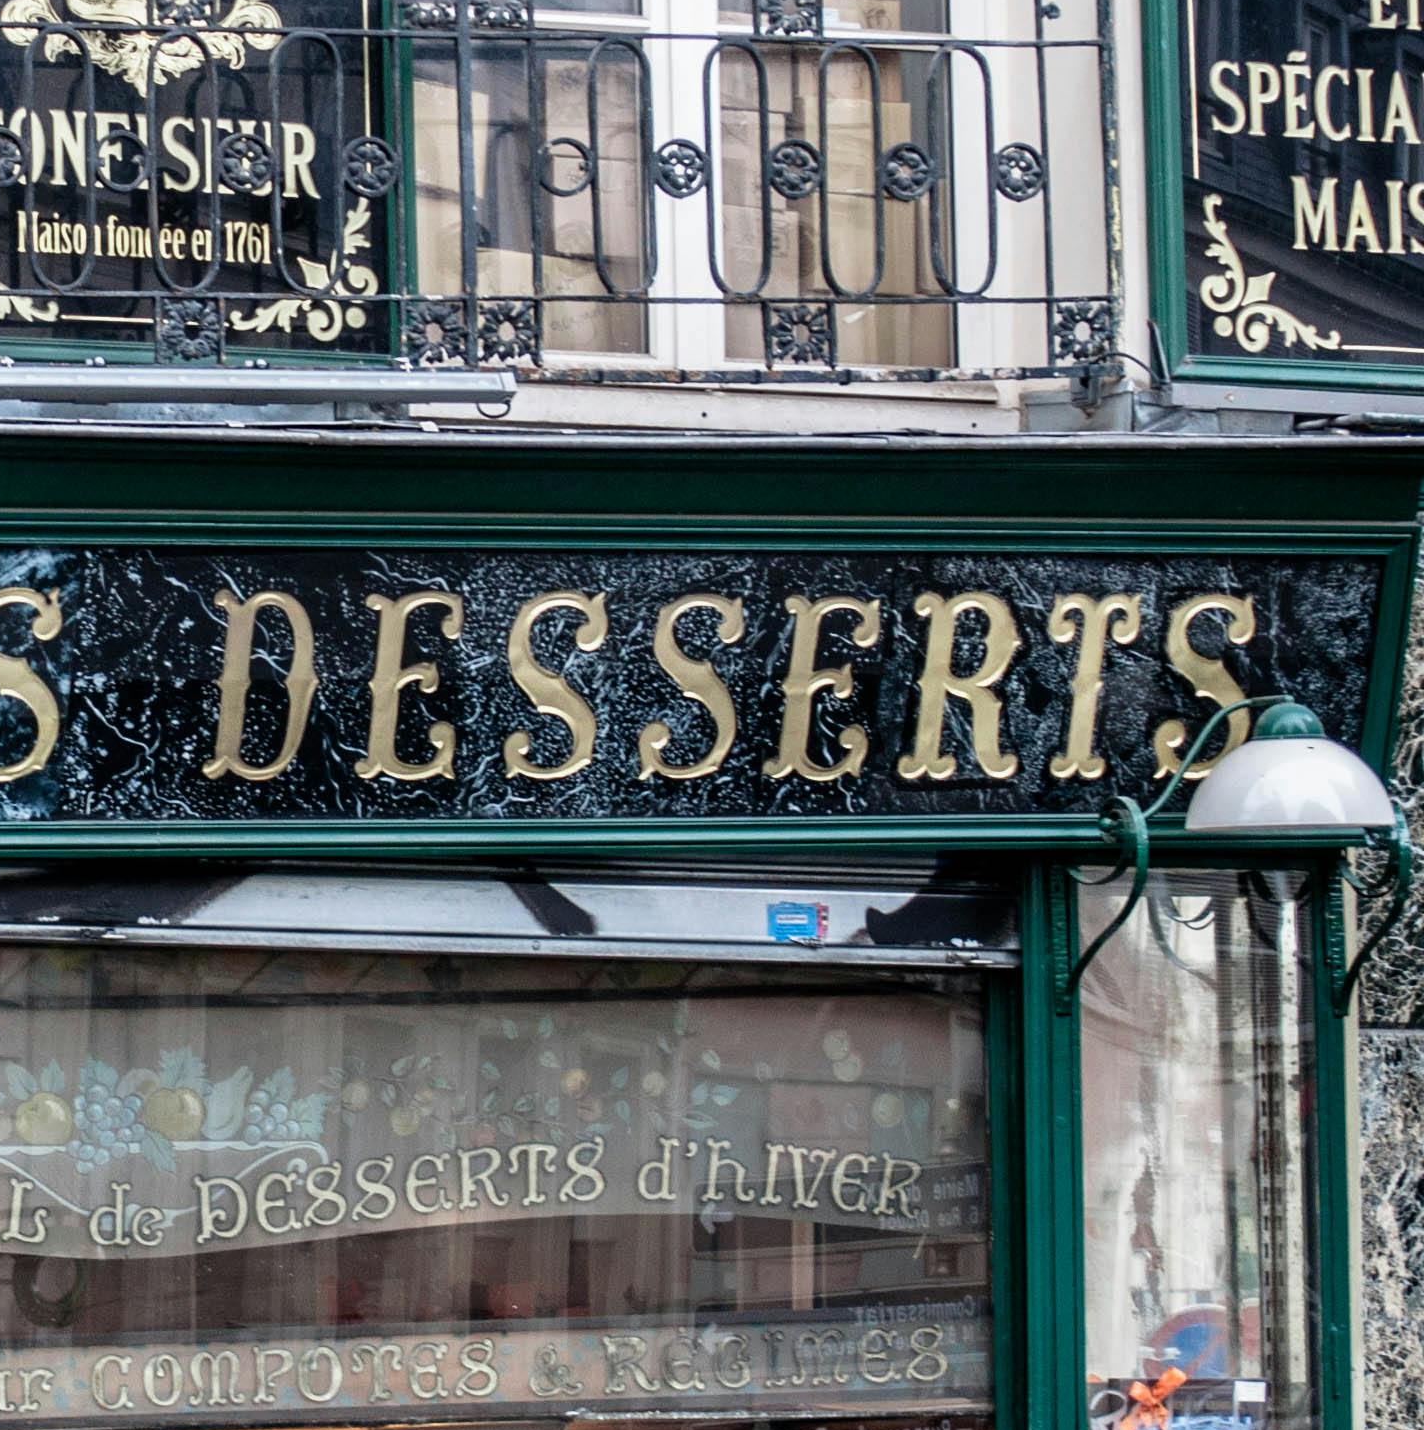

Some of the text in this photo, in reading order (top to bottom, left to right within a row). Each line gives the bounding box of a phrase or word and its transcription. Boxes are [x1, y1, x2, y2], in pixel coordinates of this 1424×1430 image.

[1209, 50, 1424, 145] SPÉCIA
[224, 221, 272, 264] 1761
[201, 590, 1256, 782] DESSERTS
[87, 1184, 164, 1248] de
[193, 1136, 605, 1245] DESSERTS
[91, 1336, 499, 1411] COMPOTES
[530, 1345, 583, 1397] &
